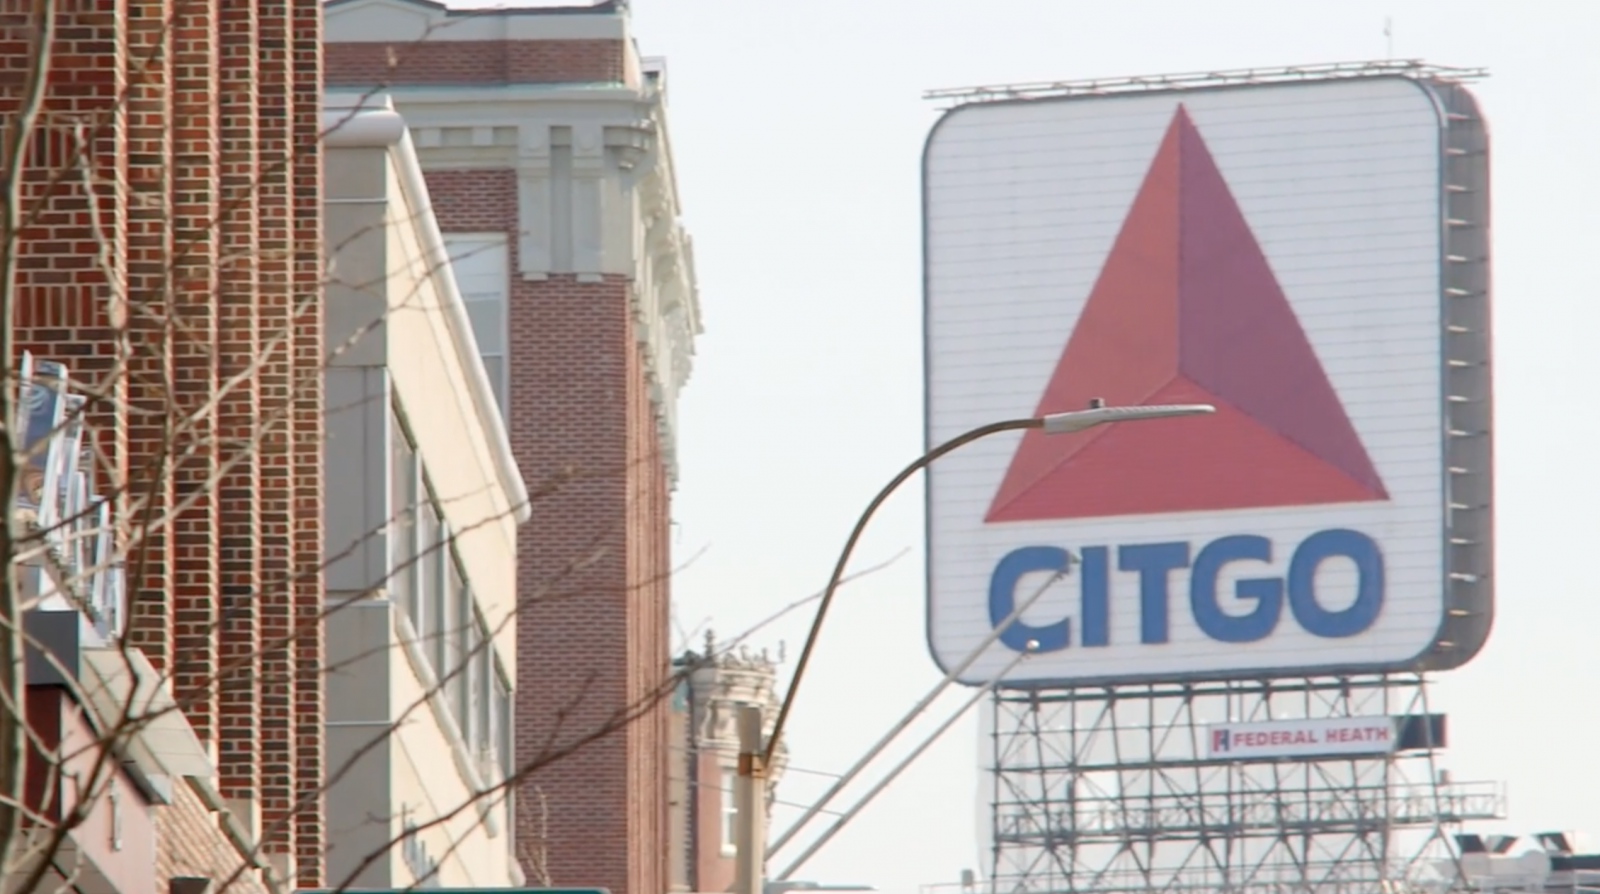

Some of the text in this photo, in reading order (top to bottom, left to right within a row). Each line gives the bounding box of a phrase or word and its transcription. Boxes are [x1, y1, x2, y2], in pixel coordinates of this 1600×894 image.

[988, 528, 1385, 653] CITGO
[1233, 729, 1318, 747] FEDERAL
[1325, 727, 1388, 742] HEATH
